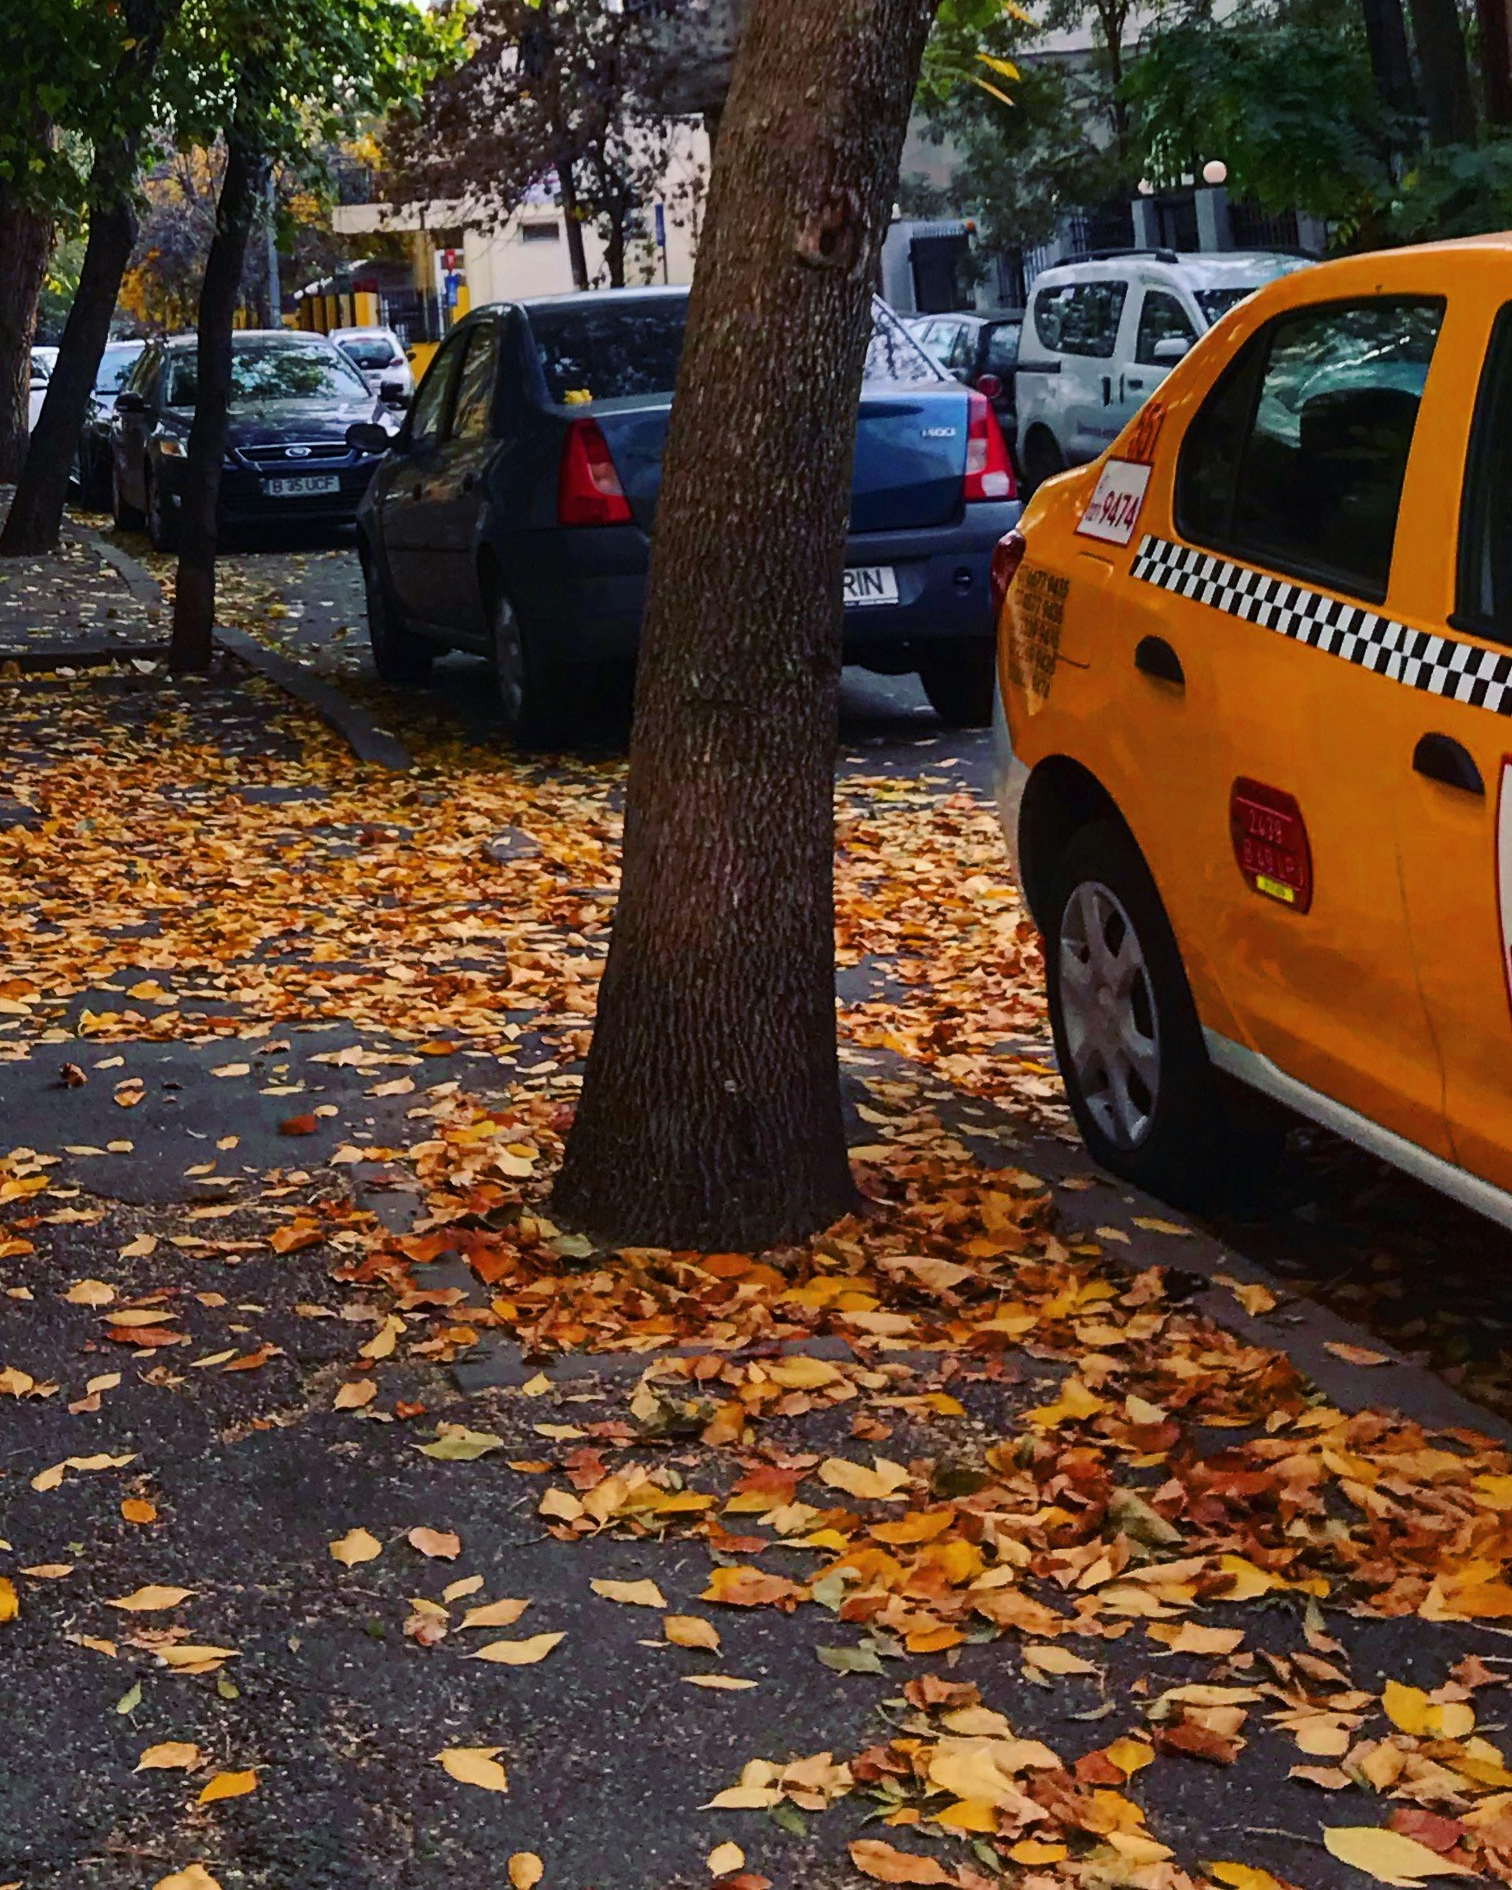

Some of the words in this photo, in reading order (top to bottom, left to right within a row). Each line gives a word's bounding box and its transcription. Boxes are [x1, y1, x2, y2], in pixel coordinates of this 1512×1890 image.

[272, 479, 283, 493] B
[1098, 490, 1140, 531] 9474
[842, 567, 885, 597] RIN
